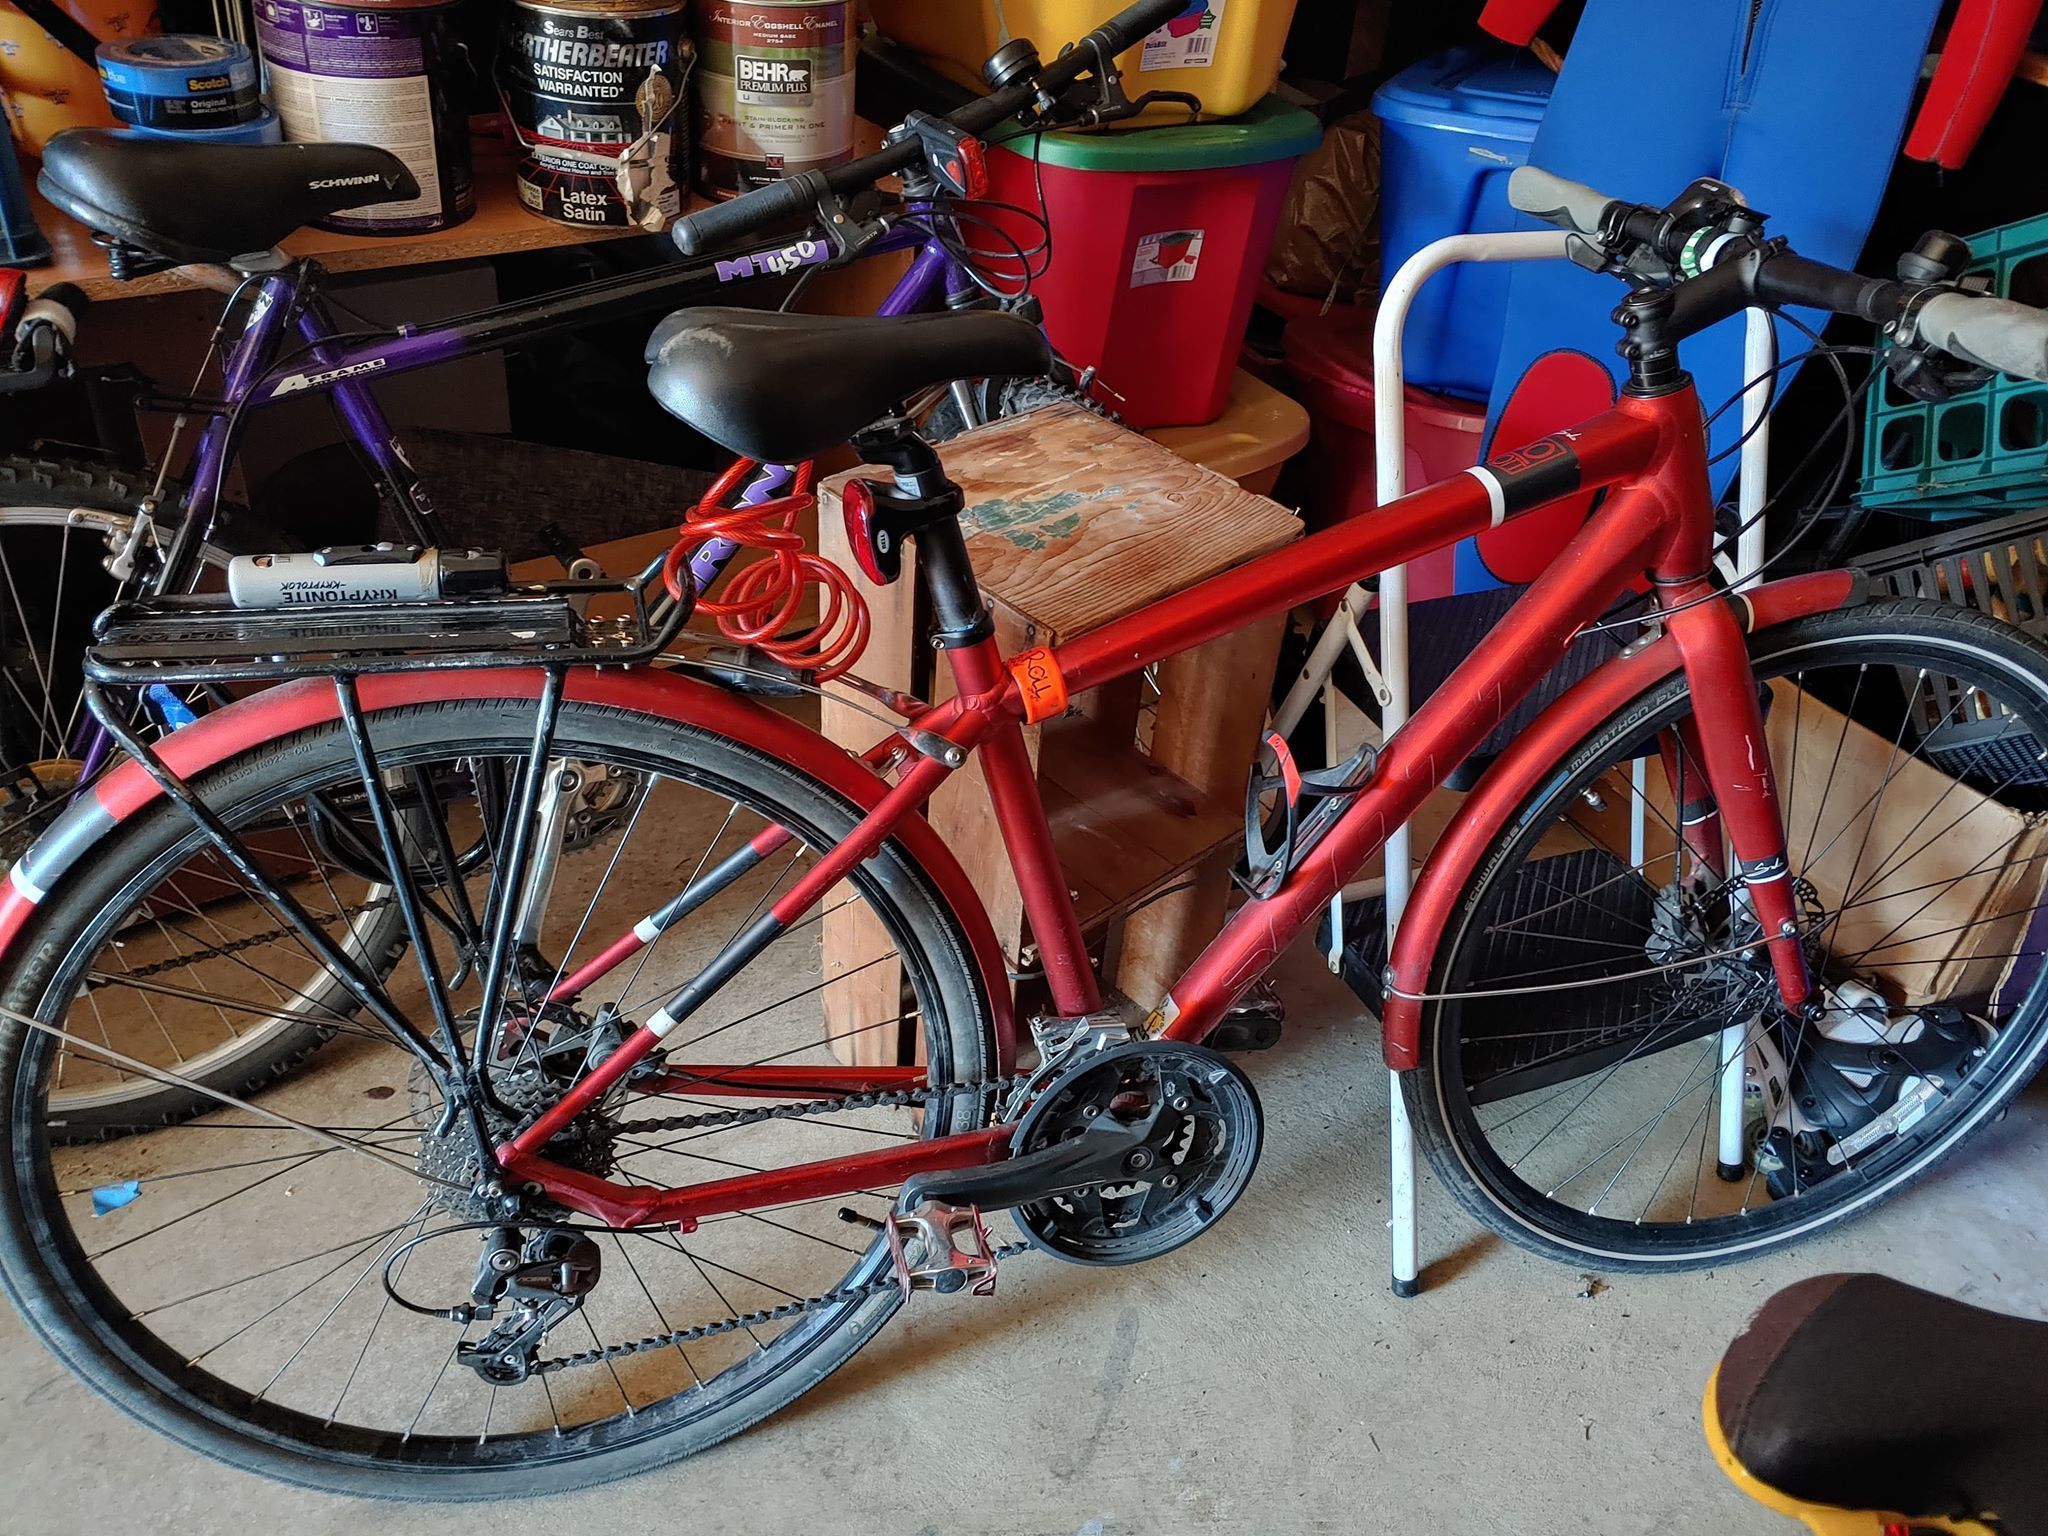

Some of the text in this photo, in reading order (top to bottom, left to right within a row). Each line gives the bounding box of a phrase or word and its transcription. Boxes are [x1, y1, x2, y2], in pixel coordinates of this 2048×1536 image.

[543, 20, 574, 38] Sears
[518, 31, 669, 68] ATHERBEATER
[533, 62, 624, 84] SATISFACTION
[739, 59, 789, 82] BEHR
[188, 77, 230, 92] Scotch
[740, 80, 808, 93] PREMIUM PLUS
[190, 98, 227, 109] Original
[759, 123, 794, 131] PRIMER
[578, 161, 599, 171] COAT
[308, 173, 380, 190] SCHWINN
[560, 186, 608, 206] Latex
[562, 203, 606, 222] Satin
[282, 588, 398, 605] KRYPTONITE
[1571, 683, 1691, 772] MARATHON PLU
[1465, 823, 1520, 914] SCHWALBE
